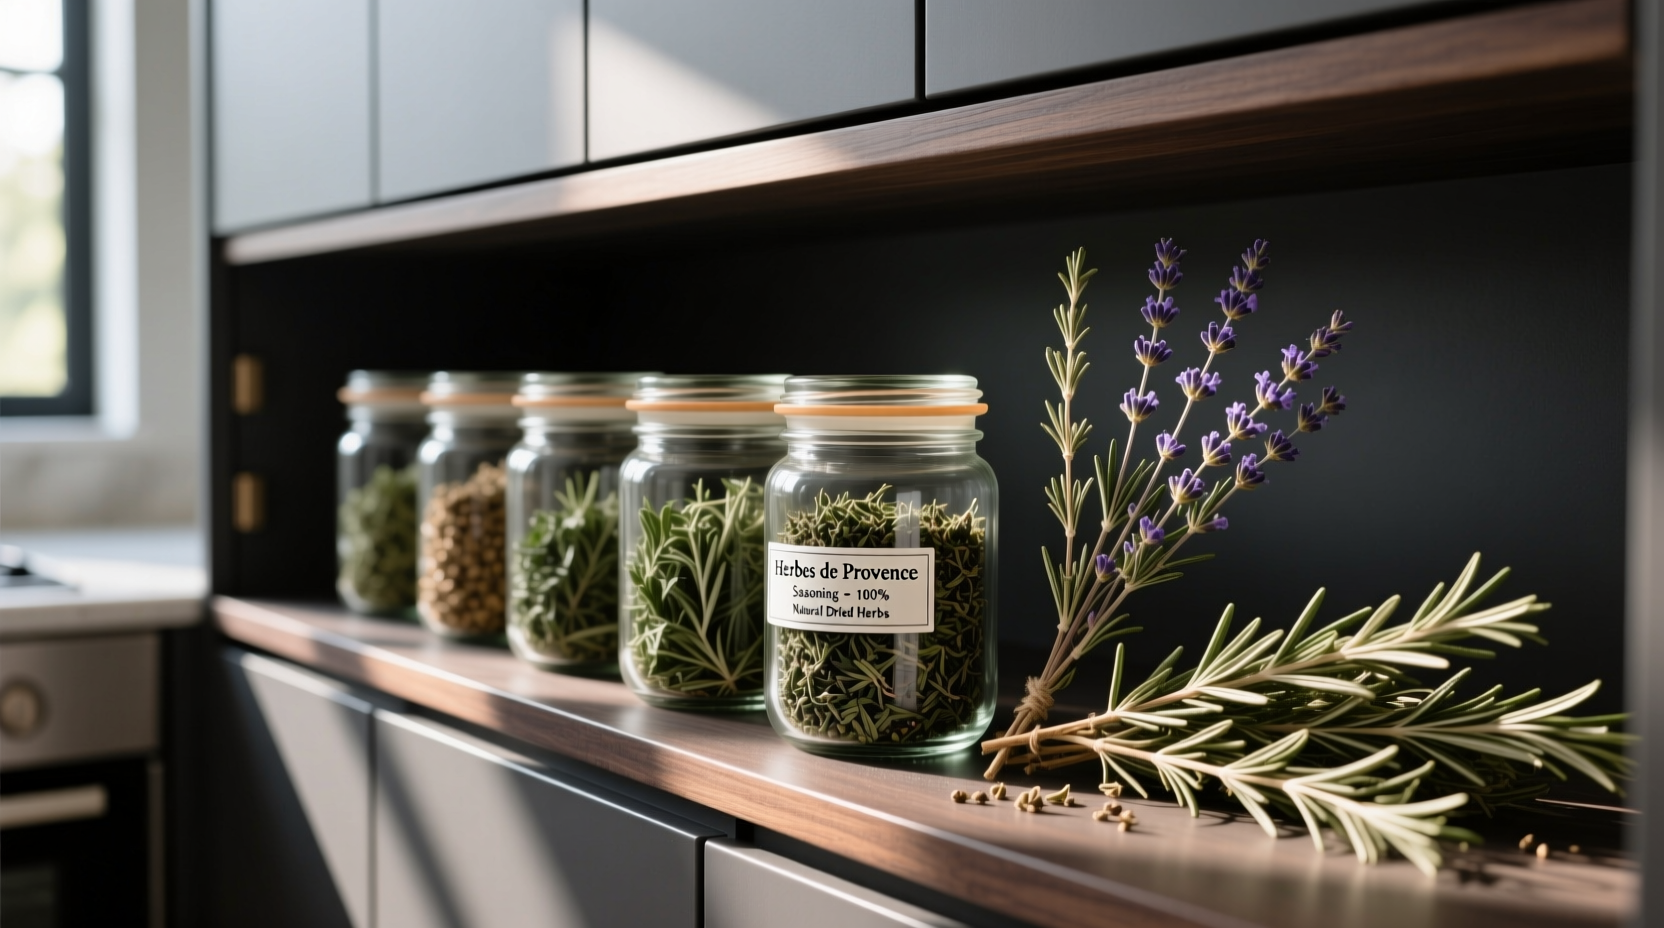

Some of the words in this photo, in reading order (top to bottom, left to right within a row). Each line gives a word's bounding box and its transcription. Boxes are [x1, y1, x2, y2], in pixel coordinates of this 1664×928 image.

[775, 560, 816, 578] Herbes
[820, 561, 838, 579] de
[842, 563, 919, 581] Provence
[857, 588, 890, 602] 100%
[857, 607, 890, 619] Herbs
